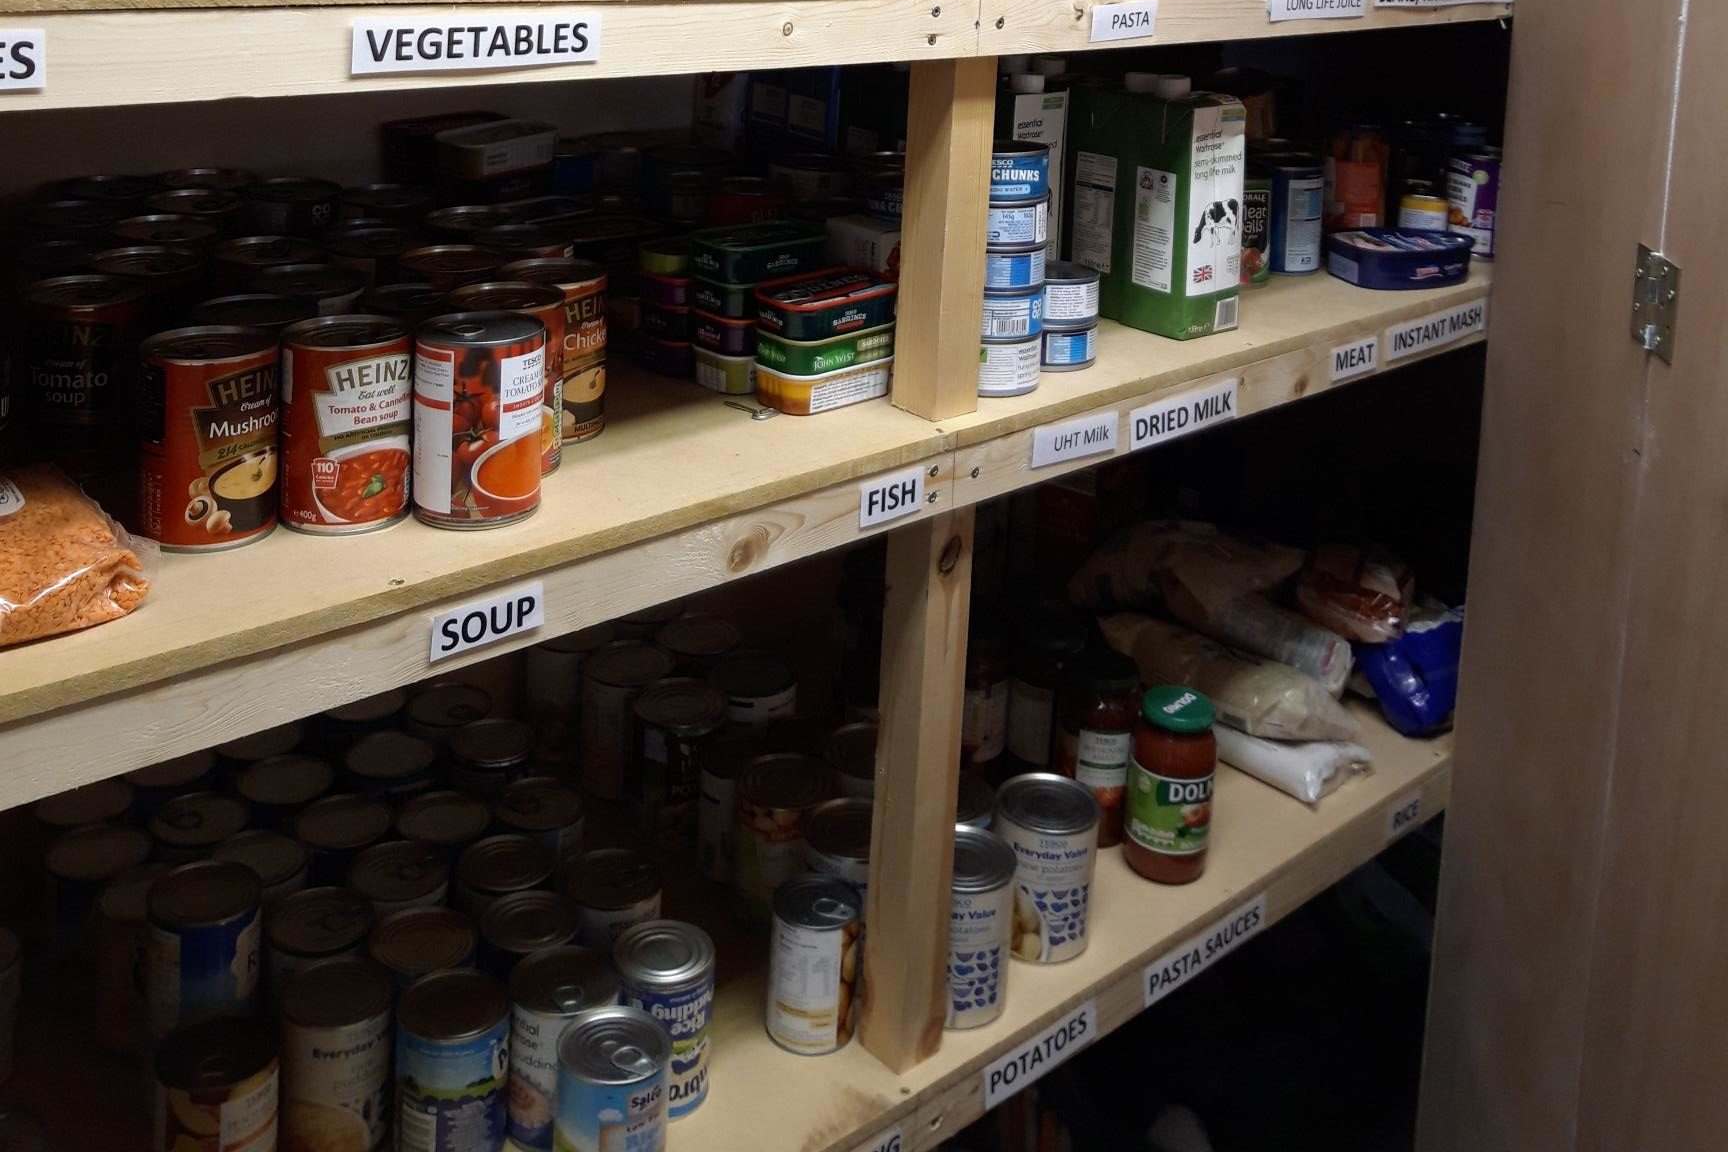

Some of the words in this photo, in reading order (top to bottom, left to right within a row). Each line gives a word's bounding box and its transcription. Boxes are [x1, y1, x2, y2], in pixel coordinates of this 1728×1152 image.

[1111, 11, 1150, 30] PASTA
[366, 21, 589, 62] VEGETABLES
[1196, 129, 1222, 143] essential
[992, 159, 1013, 167] ESCO
[1194, 152, 1242, 168] semi-skimmed
[992, 169, 1040, 182] CHUNKS
[1194, 168, 1208, 181] long
[1209, 167, 1220, 176] life
[1221, 165, 1236, 175] milk
[1393, 318, 1447, 352] INSTANT
[1448, 306, 1483, 333] MASH
[522, 354, 543, 367] TESCO
[813, 356, 834, 371] JOHN
[835, 351, 856, 364] WEST
[1335, 343, 1375, 372] MEAT
[30, 365, 109, 389] Tomato
[335, 358, 410, 392] HEINZ
[512, 372, 539, 386] CREAM
[218, 368, 275, 404] HEIN
[358, 389, 375, 400] Eat
[377, 384, 396, 398] well
[504, 384, 536, 398] TOMATO
[328, 403, 367, 415] Tomato
[369, 402, 377, 411] &
[353, 415, 378, 425] Bean
[379, 409, 399, 422] soup
[1134, 405, 1190, 442] DRIED
[1193, 389, 1233, 425] MILK
[1053, 431, 1080, 452] UHT
[1082, 423, 1111, 447] Milk
[317, 462, 334, 474] 110
[866, 479, 917, 517] FISH
[441, 596, 536, 652] SOUP
[1393, 799, 1420, 831] RICE
[1013, 842, 1062, 861] Everyday
[1205, 905, 1262, 957] SAUCES
[1149, 950, 1202, 996] PASTA
[989, 1011, 1088, 1095] POTATOES
